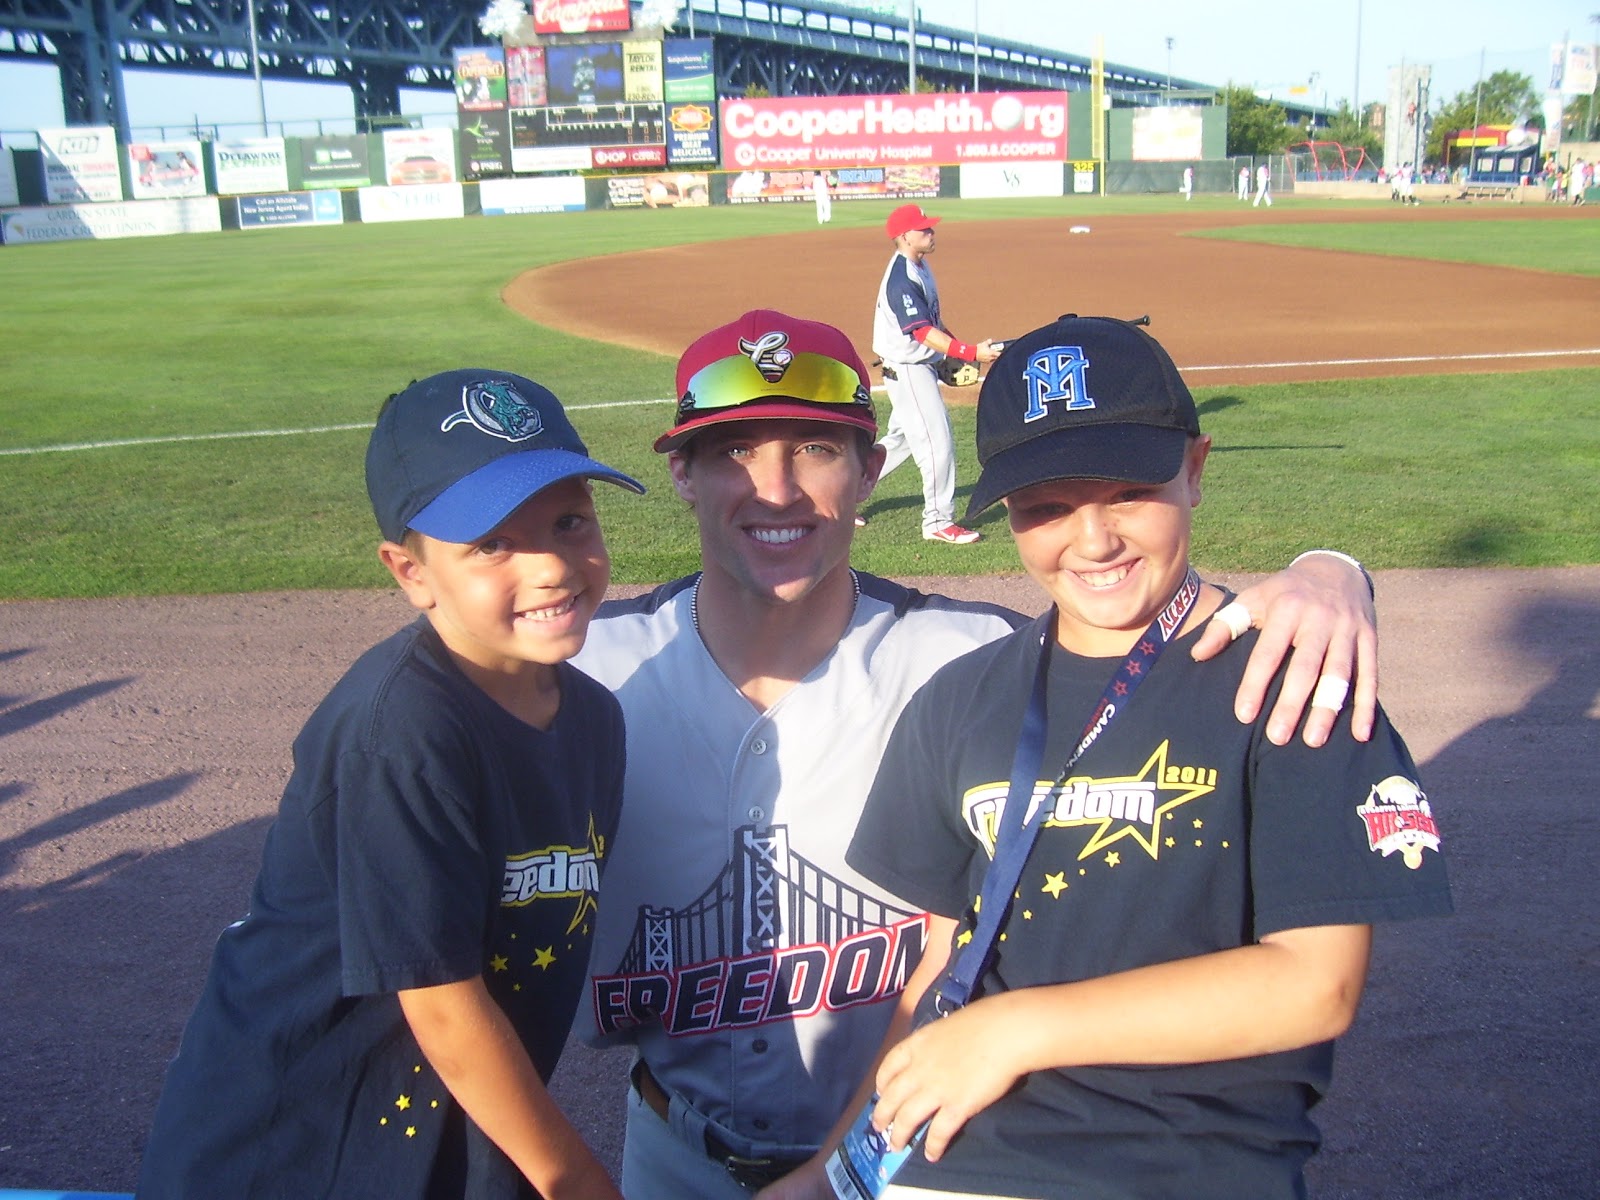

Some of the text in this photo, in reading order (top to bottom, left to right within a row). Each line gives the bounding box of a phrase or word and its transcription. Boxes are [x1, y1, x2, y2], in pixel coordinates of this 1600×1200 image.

[756, 146, 811, 164] Cooper
[815, 145, 878, 162] University
[881, 143, 933, 160] Hospital
[1073, 163, 1094, 173] 325
[48, 207, 92, 221] GARDEN
[26, 225, 68, 239] FEDERAL
[72, 223, 115, 237] CREDIT
[1165, 766, 1218, 786] 2011
